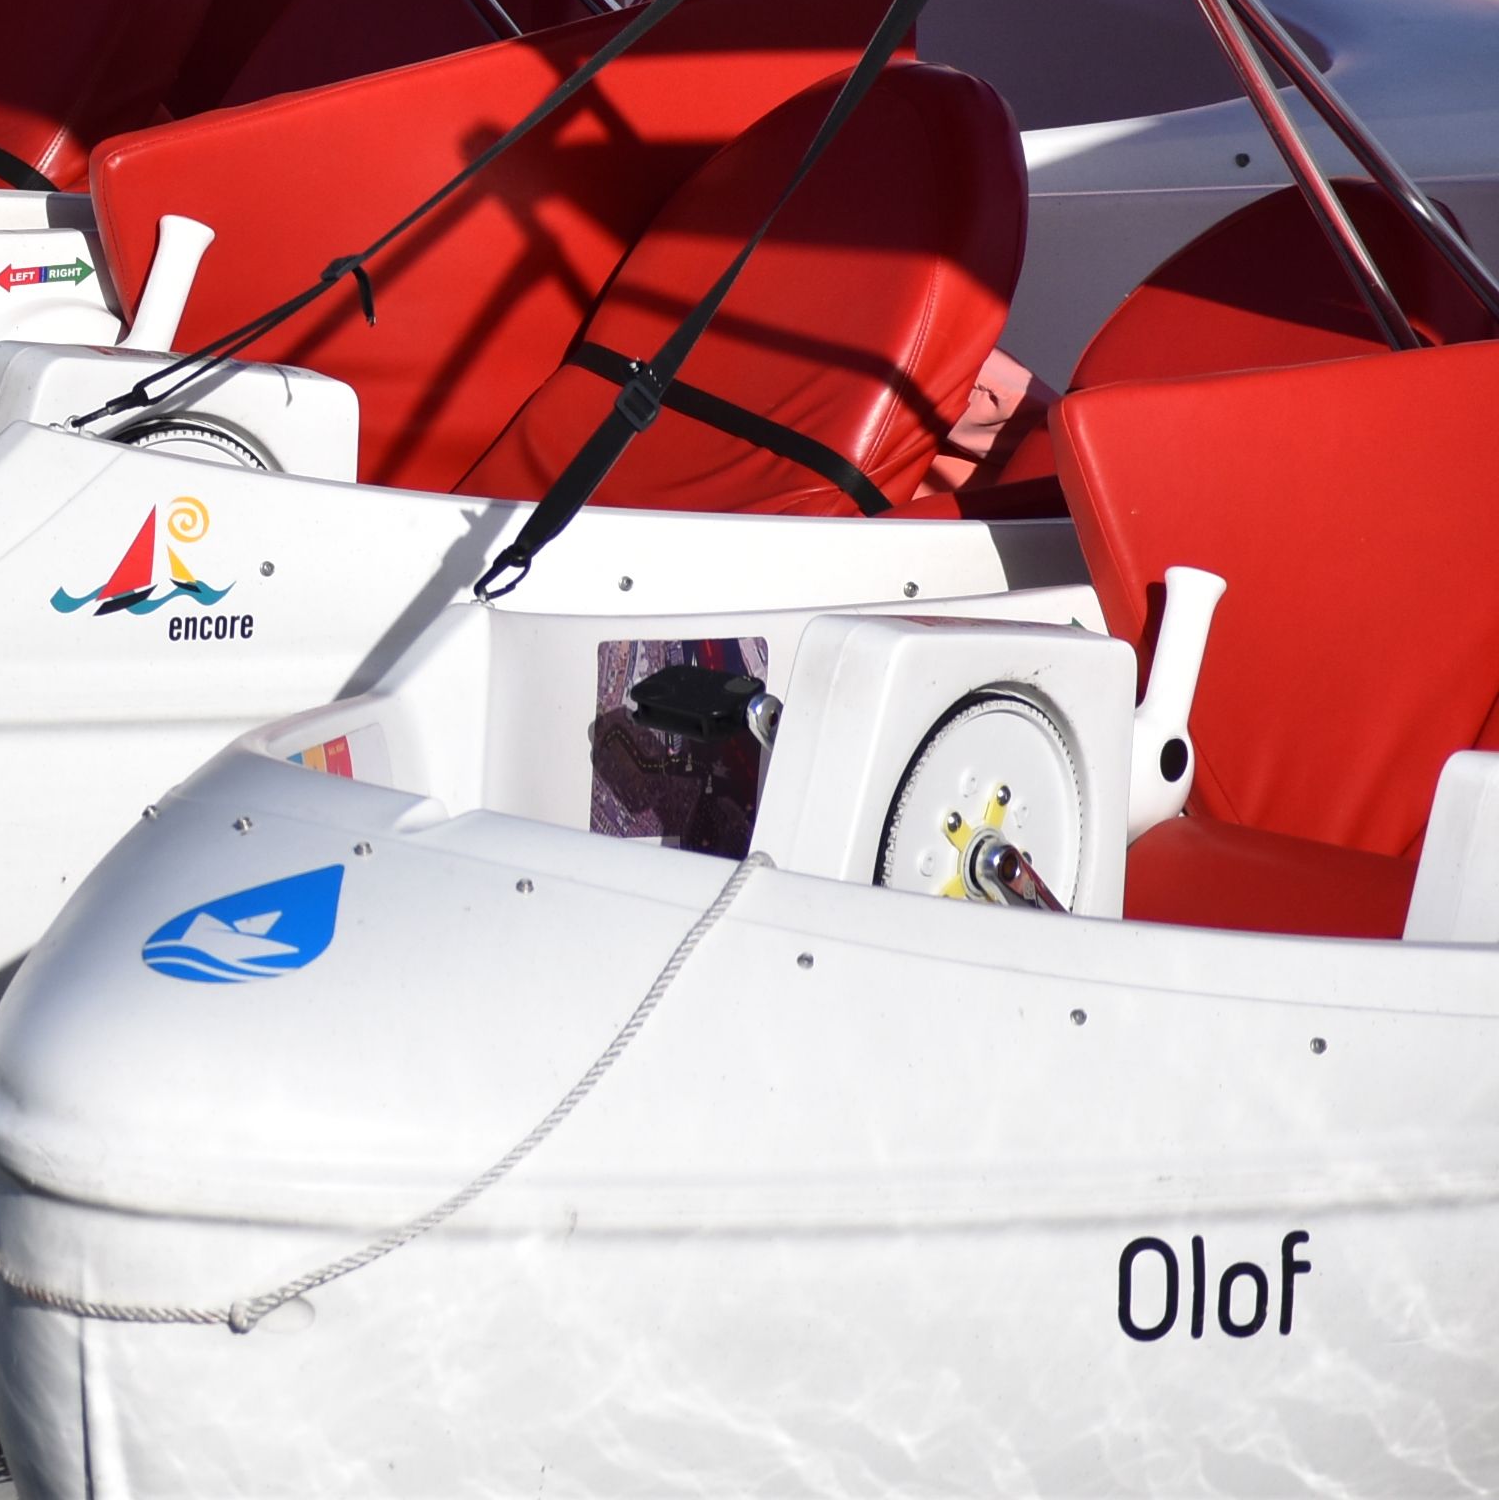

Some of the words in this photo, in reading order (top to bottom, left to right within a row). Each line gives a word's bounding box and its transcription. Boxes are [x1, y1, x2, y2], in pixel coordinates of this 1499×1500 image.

[9, 271, 36, 283] LEFT
[48, 267, 83, 279] RIGHT
[169, 614, 254, 641] encore
[1118, 1230, 1312, 1342] Olof
